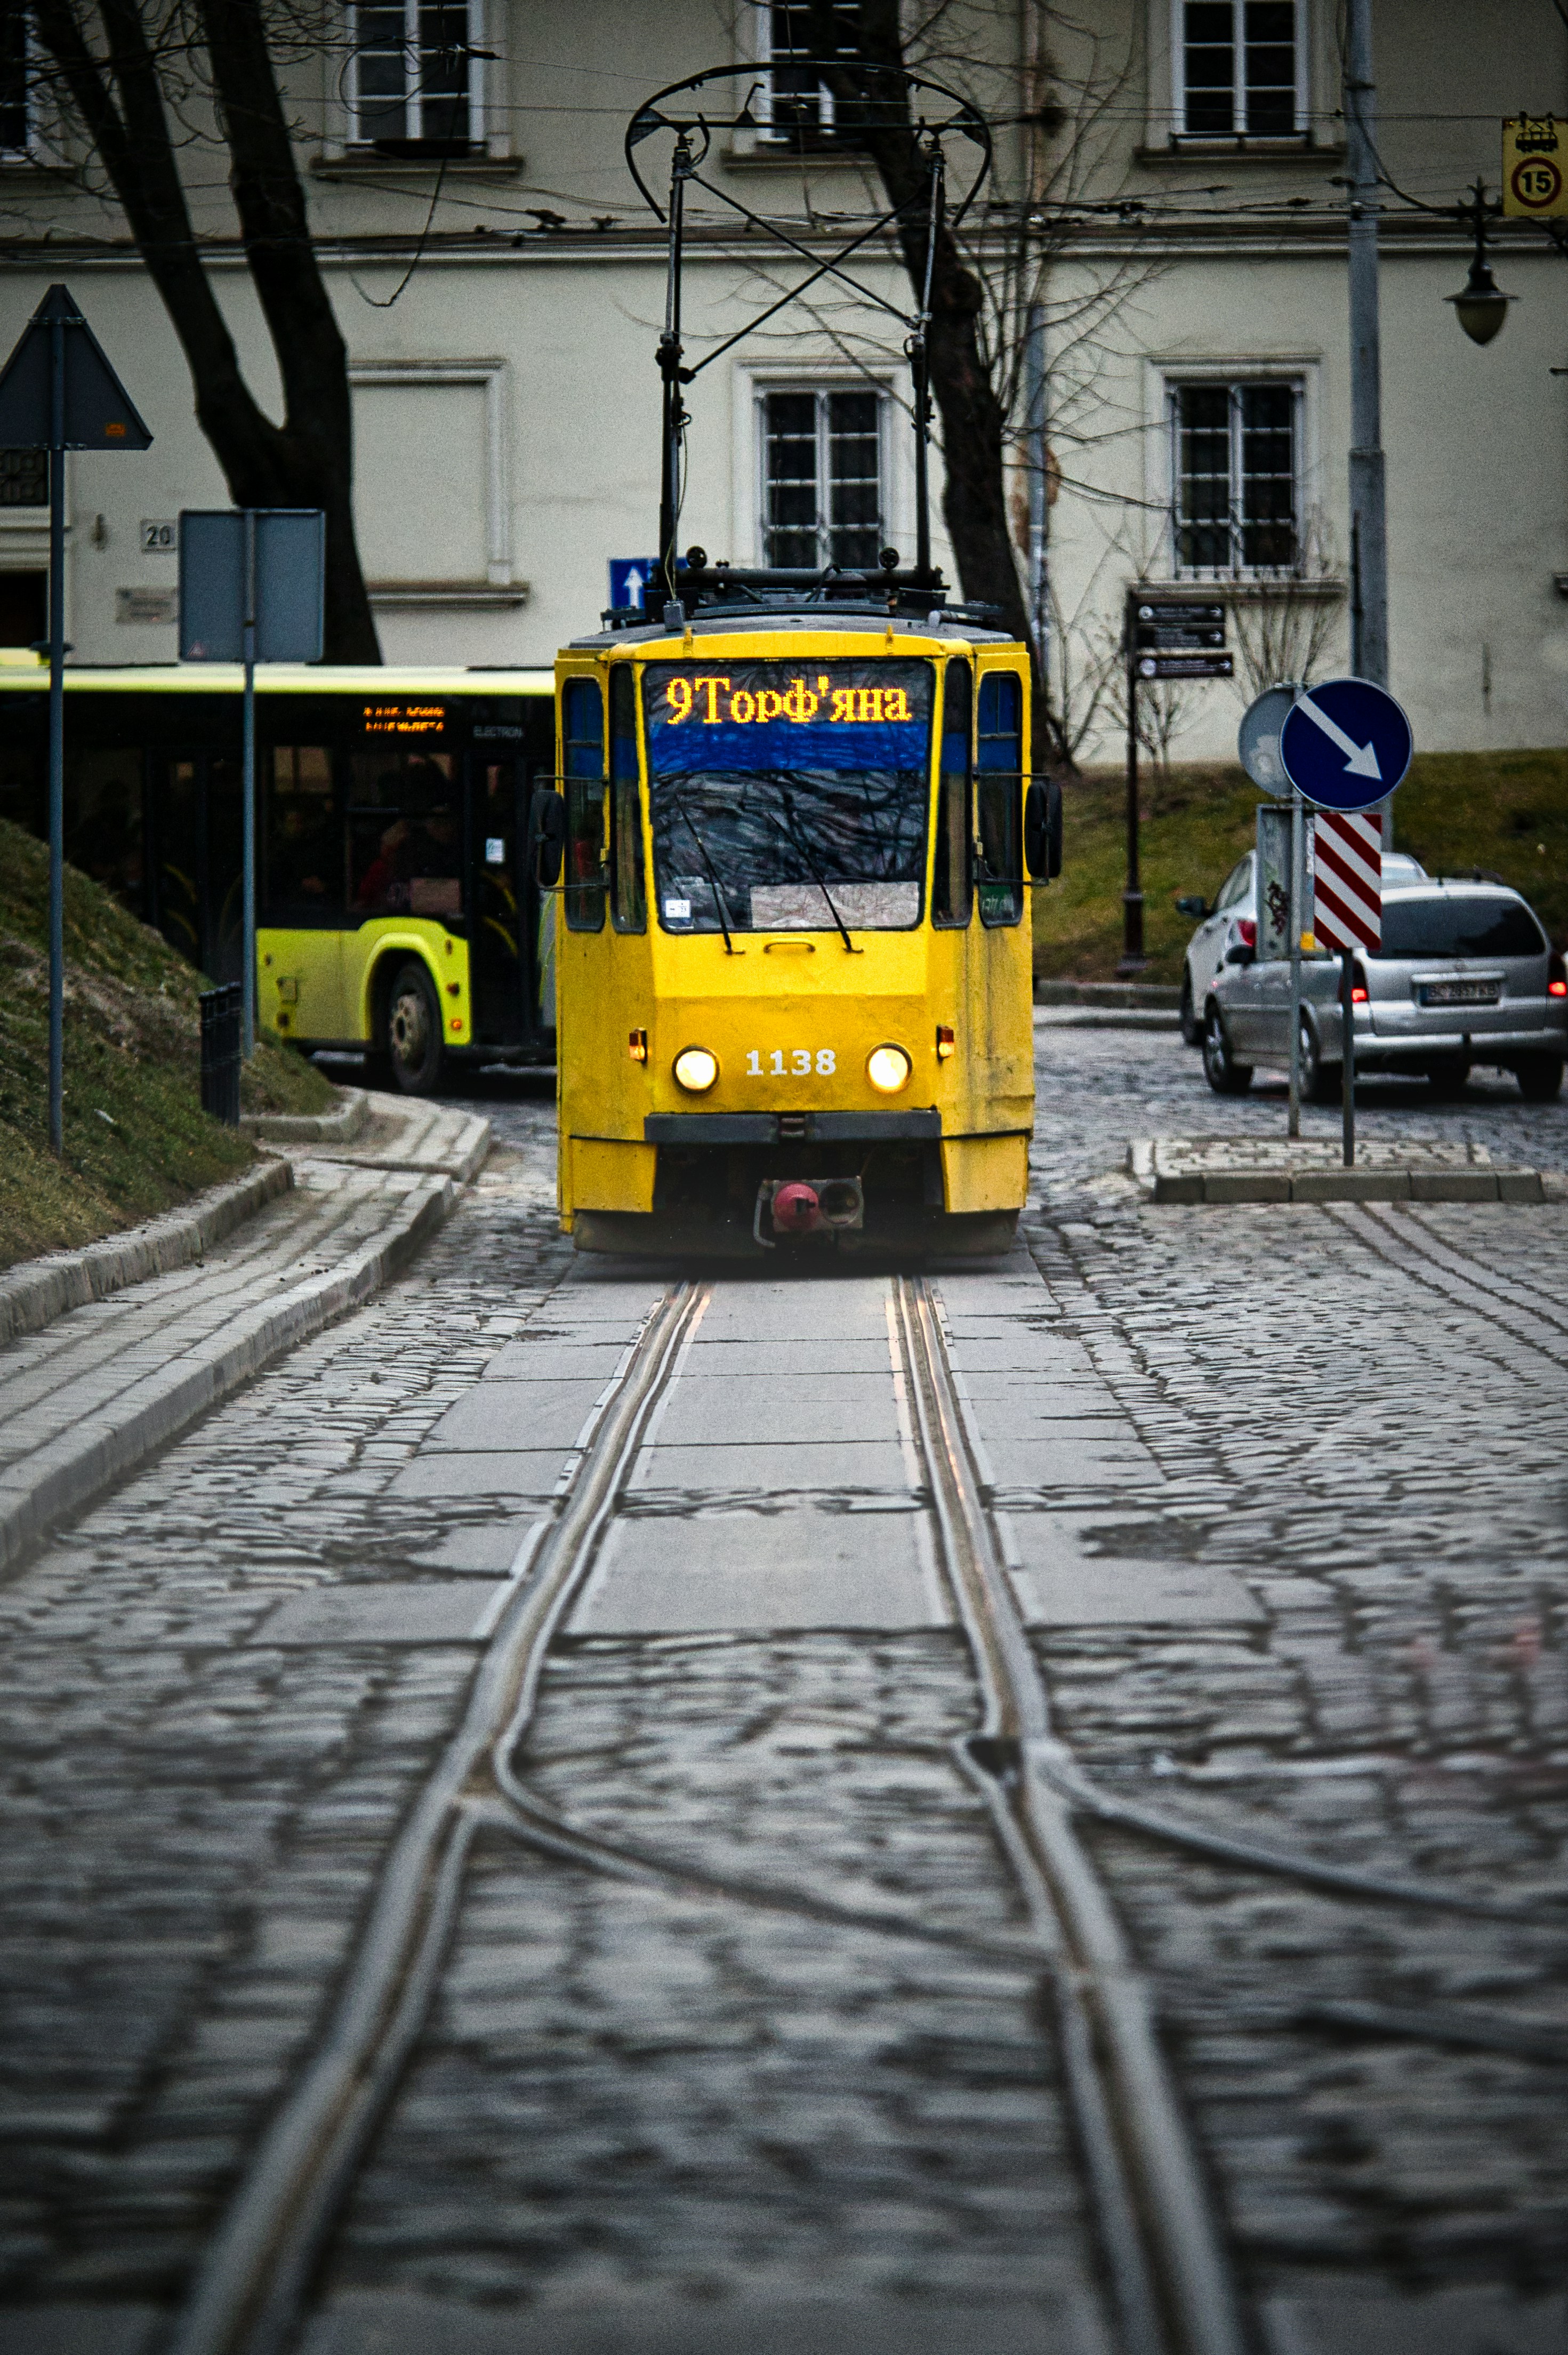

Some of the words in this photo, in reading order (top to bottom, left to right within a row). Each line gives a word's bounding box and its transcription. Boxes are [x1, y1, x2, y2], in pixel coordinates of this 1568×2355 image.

[1521, 171, 1551, 193] 15
[146, 525, 171, 546] 20
[746, 1049, 837, 1076] 1138
